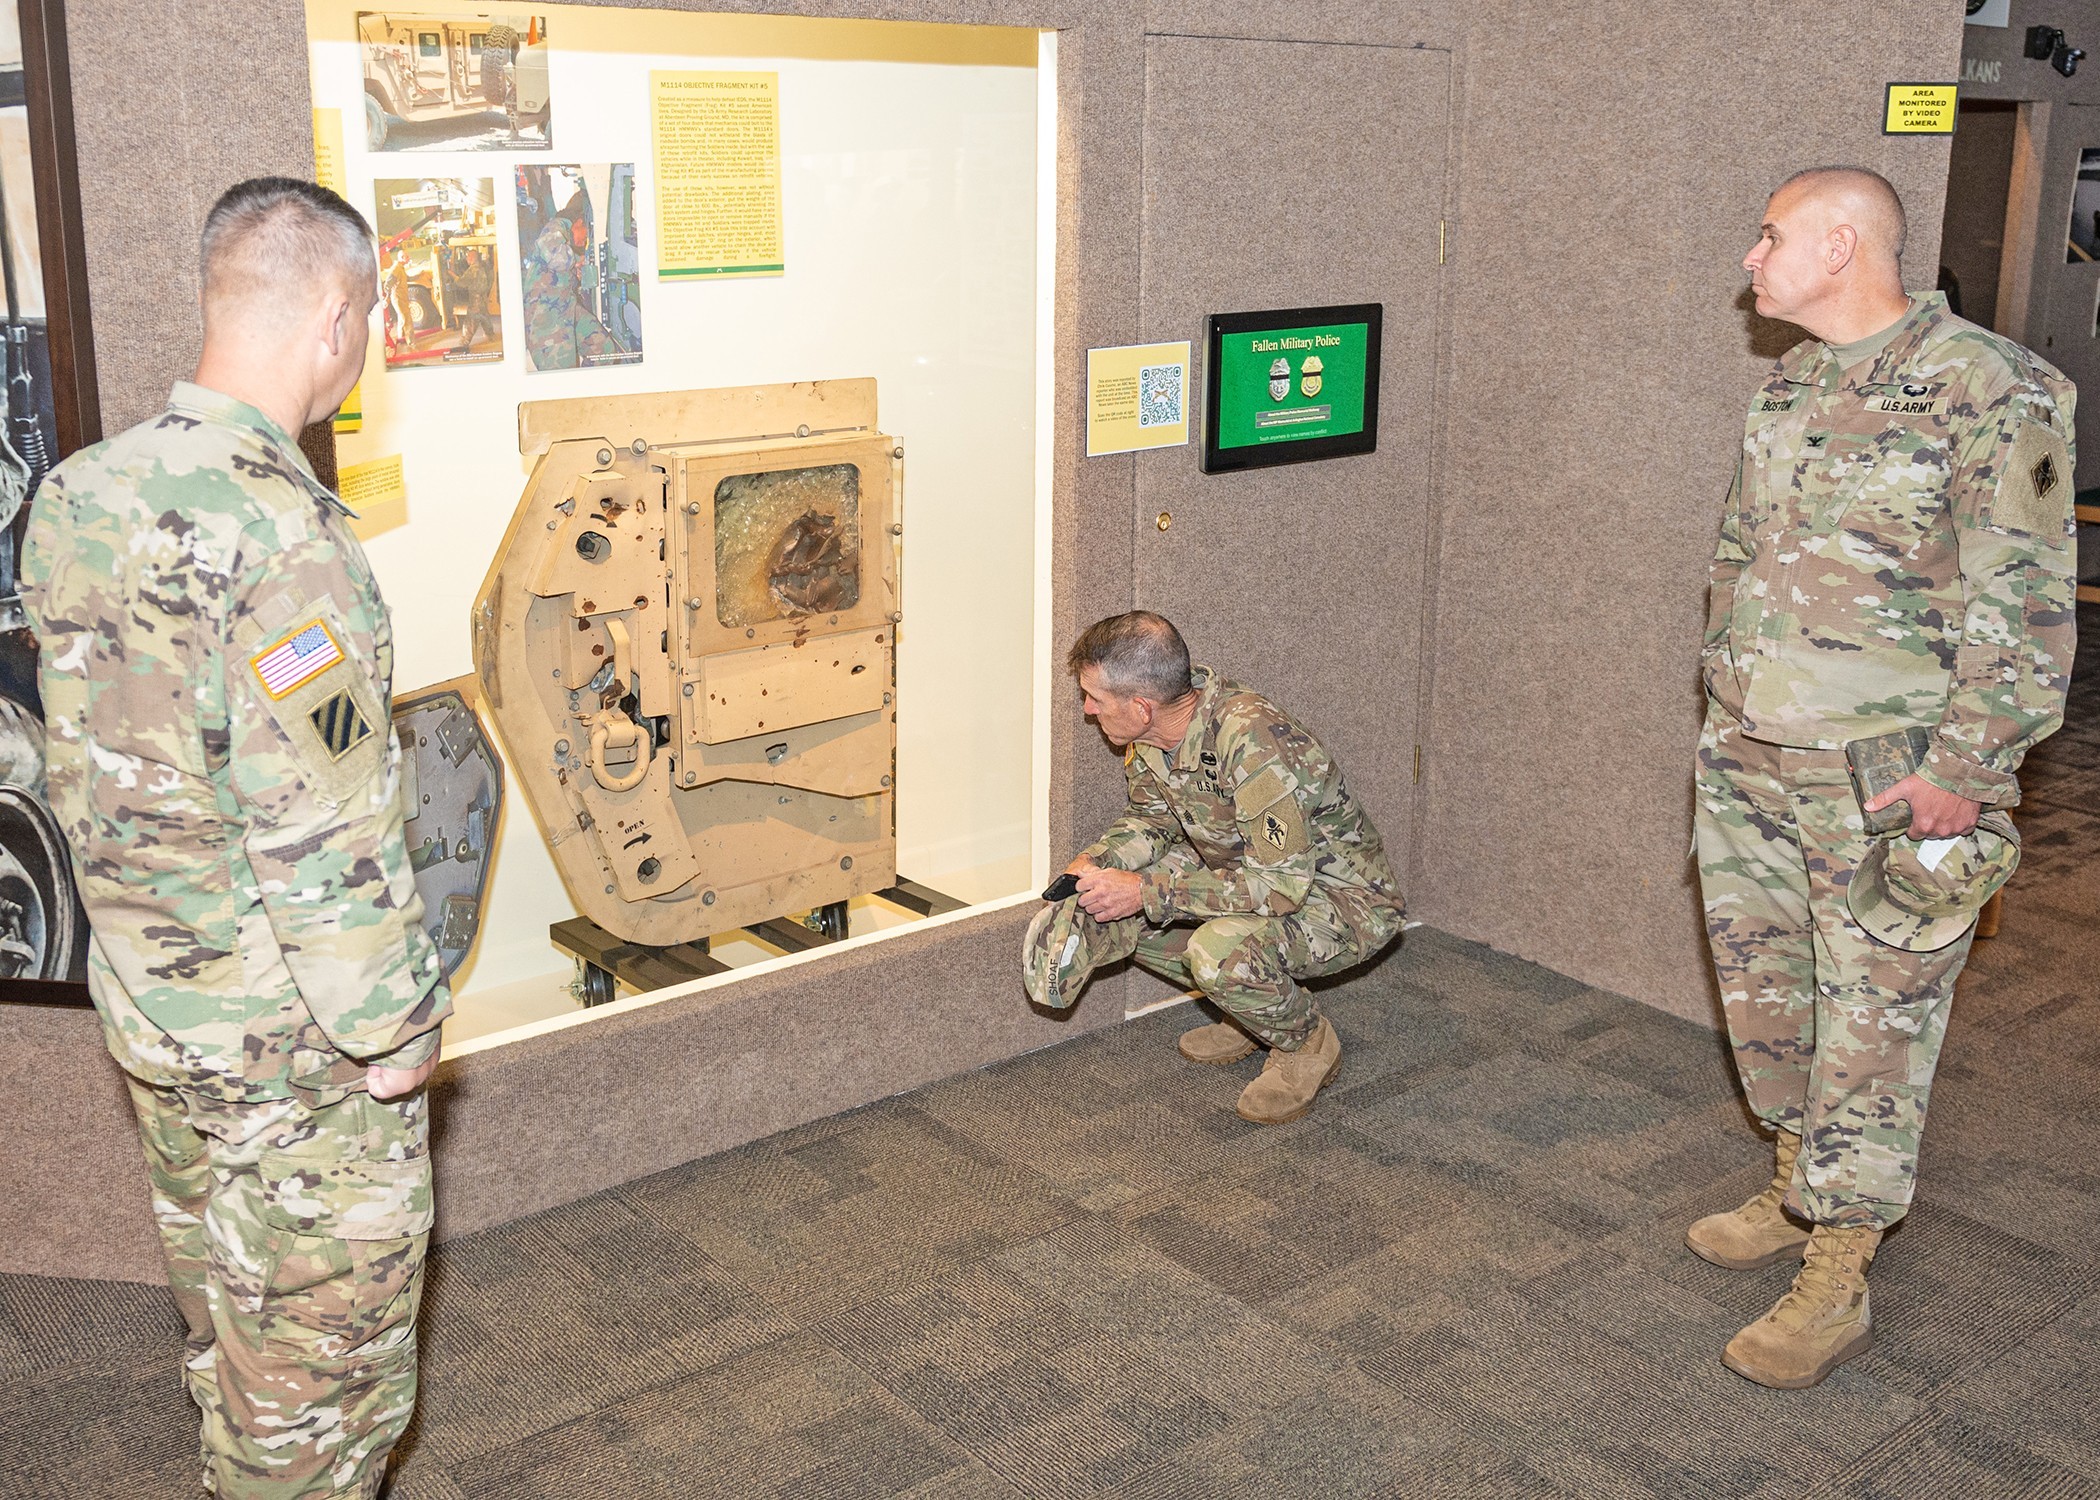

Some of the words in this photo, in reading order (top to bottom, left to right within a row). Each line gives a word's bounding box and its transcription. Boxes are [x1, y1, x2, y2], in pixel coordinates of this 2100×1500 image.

[1252, 339, 1278, 352] Fallen
[1280, 337, 1313, 350] Military
[1315, 334, 1340, 346] Police
[1761, 400, 1793, 411] BOSTON
[624, 819, 645, 834] OPEN
[1048, 958, 1059, 996] SHOAF
